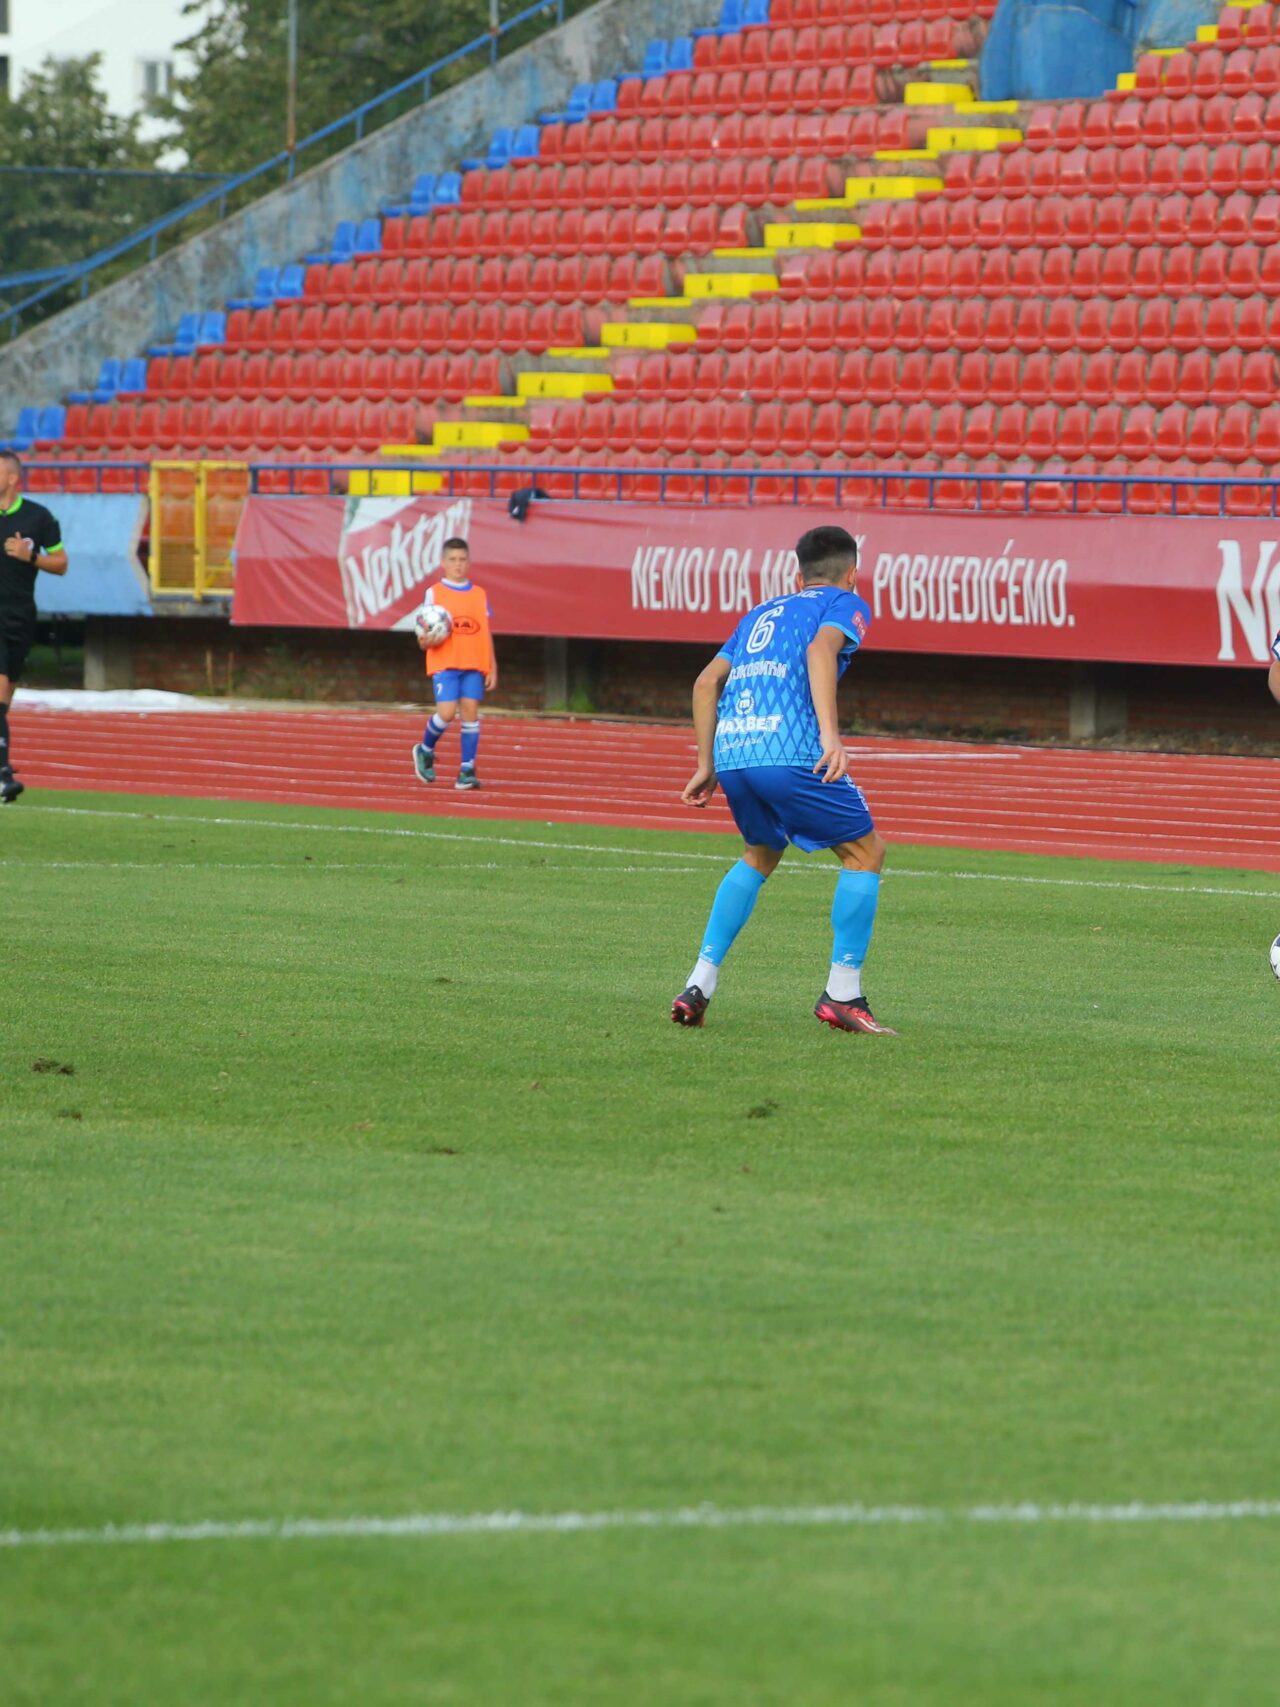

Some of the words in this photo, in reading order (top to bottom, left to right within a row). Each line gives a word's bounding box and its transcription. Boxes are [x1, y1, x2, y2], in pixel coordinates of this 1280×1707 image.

[631, 546, 714, 613] NEMOJ
[718, 548, 753, 612] DA
[873, 538, 1075, 627] POBIJEDIĆEMO.
[746, 605, 784, 654] 6
